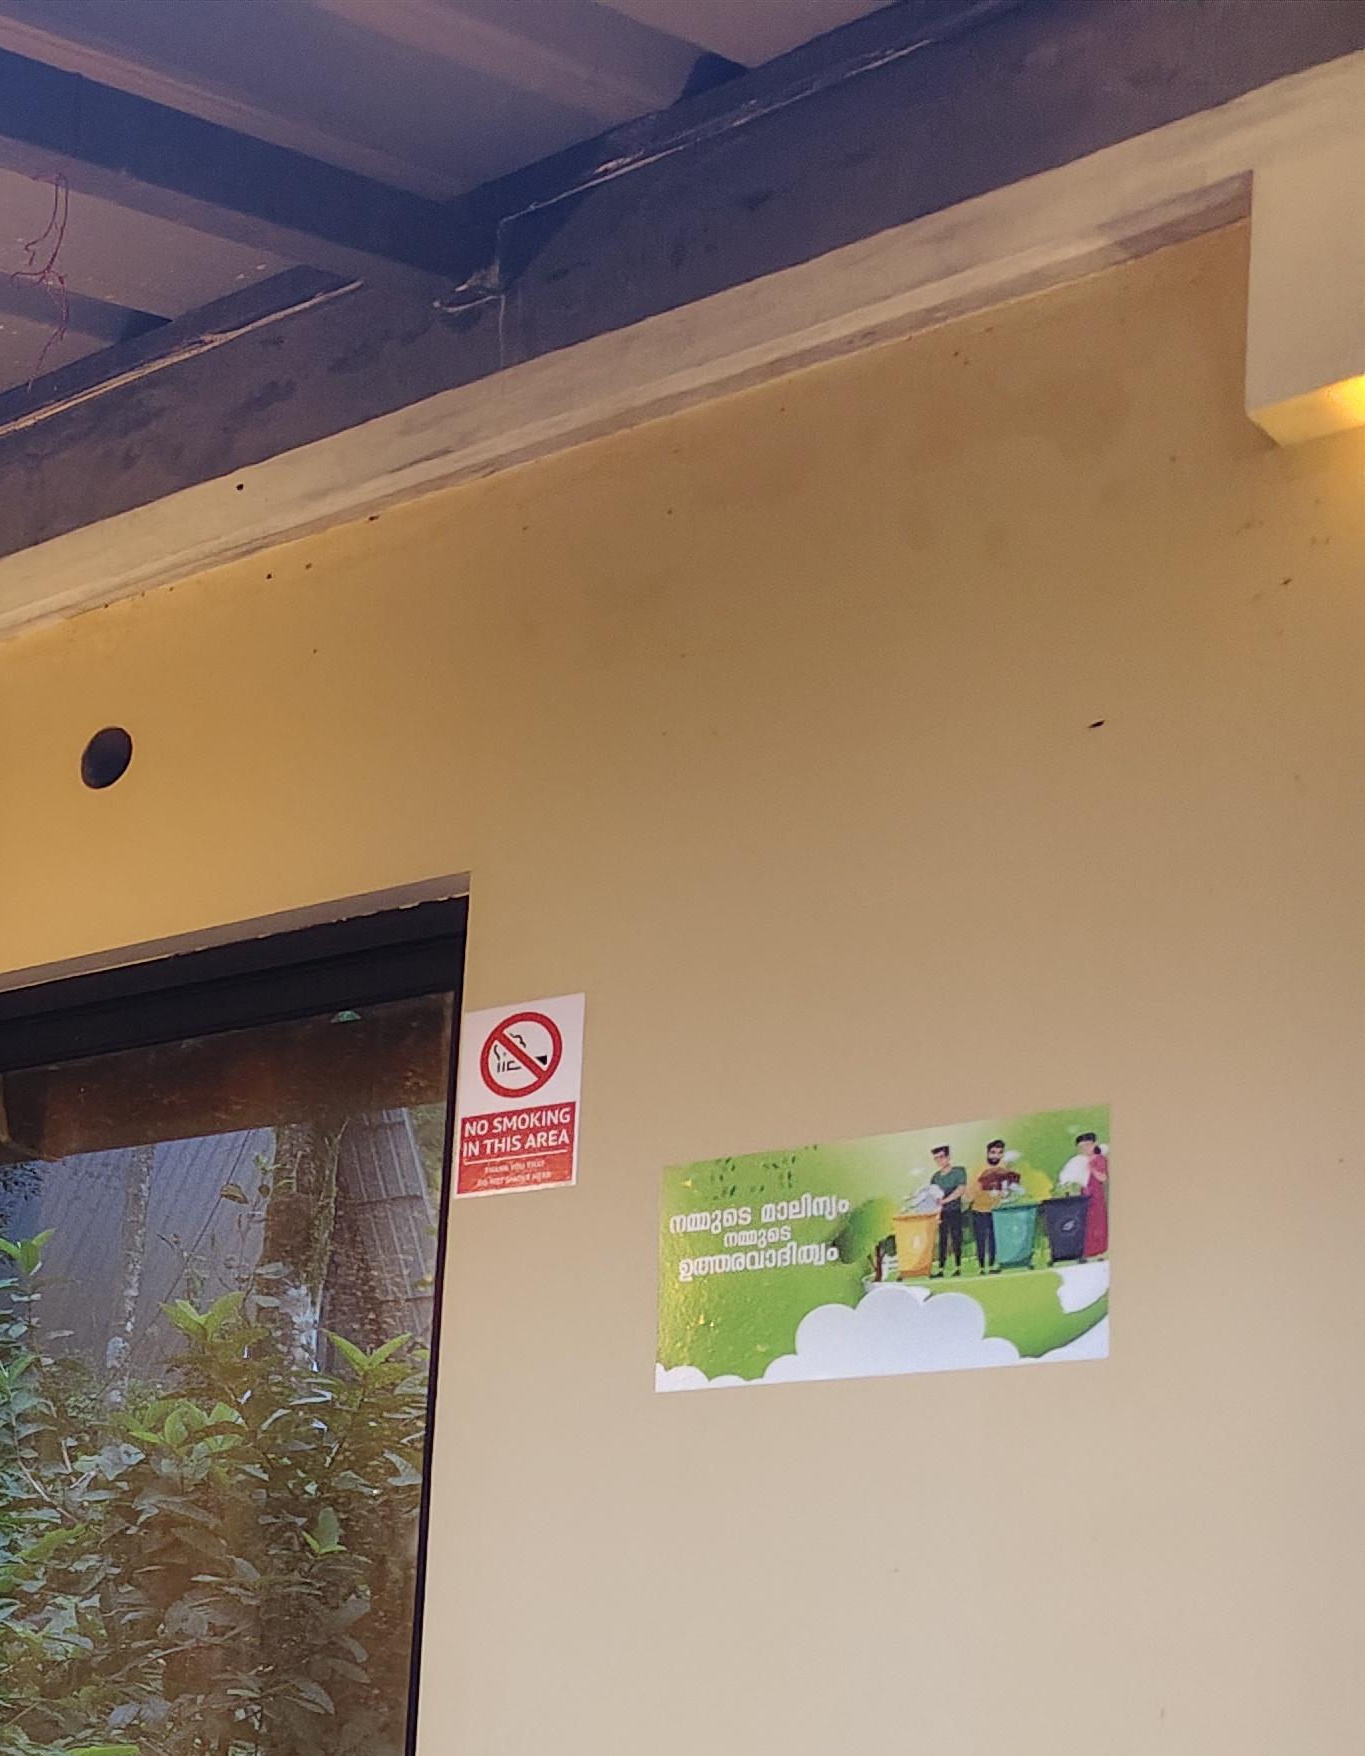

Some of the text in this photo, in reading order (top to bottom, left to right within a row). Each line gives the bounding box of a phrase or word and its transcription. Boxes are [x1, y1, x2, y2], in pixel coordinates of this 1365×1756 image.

[464, 1106, 571, 1138] NO SMOKING
[462, 1128, 570, 1158] IN THIS AREA
[669, 1191, 850, 1235] നമ്മുടെ മാലിന്യം
[723, 1225, 792, 1249] നമ്മുടെ
